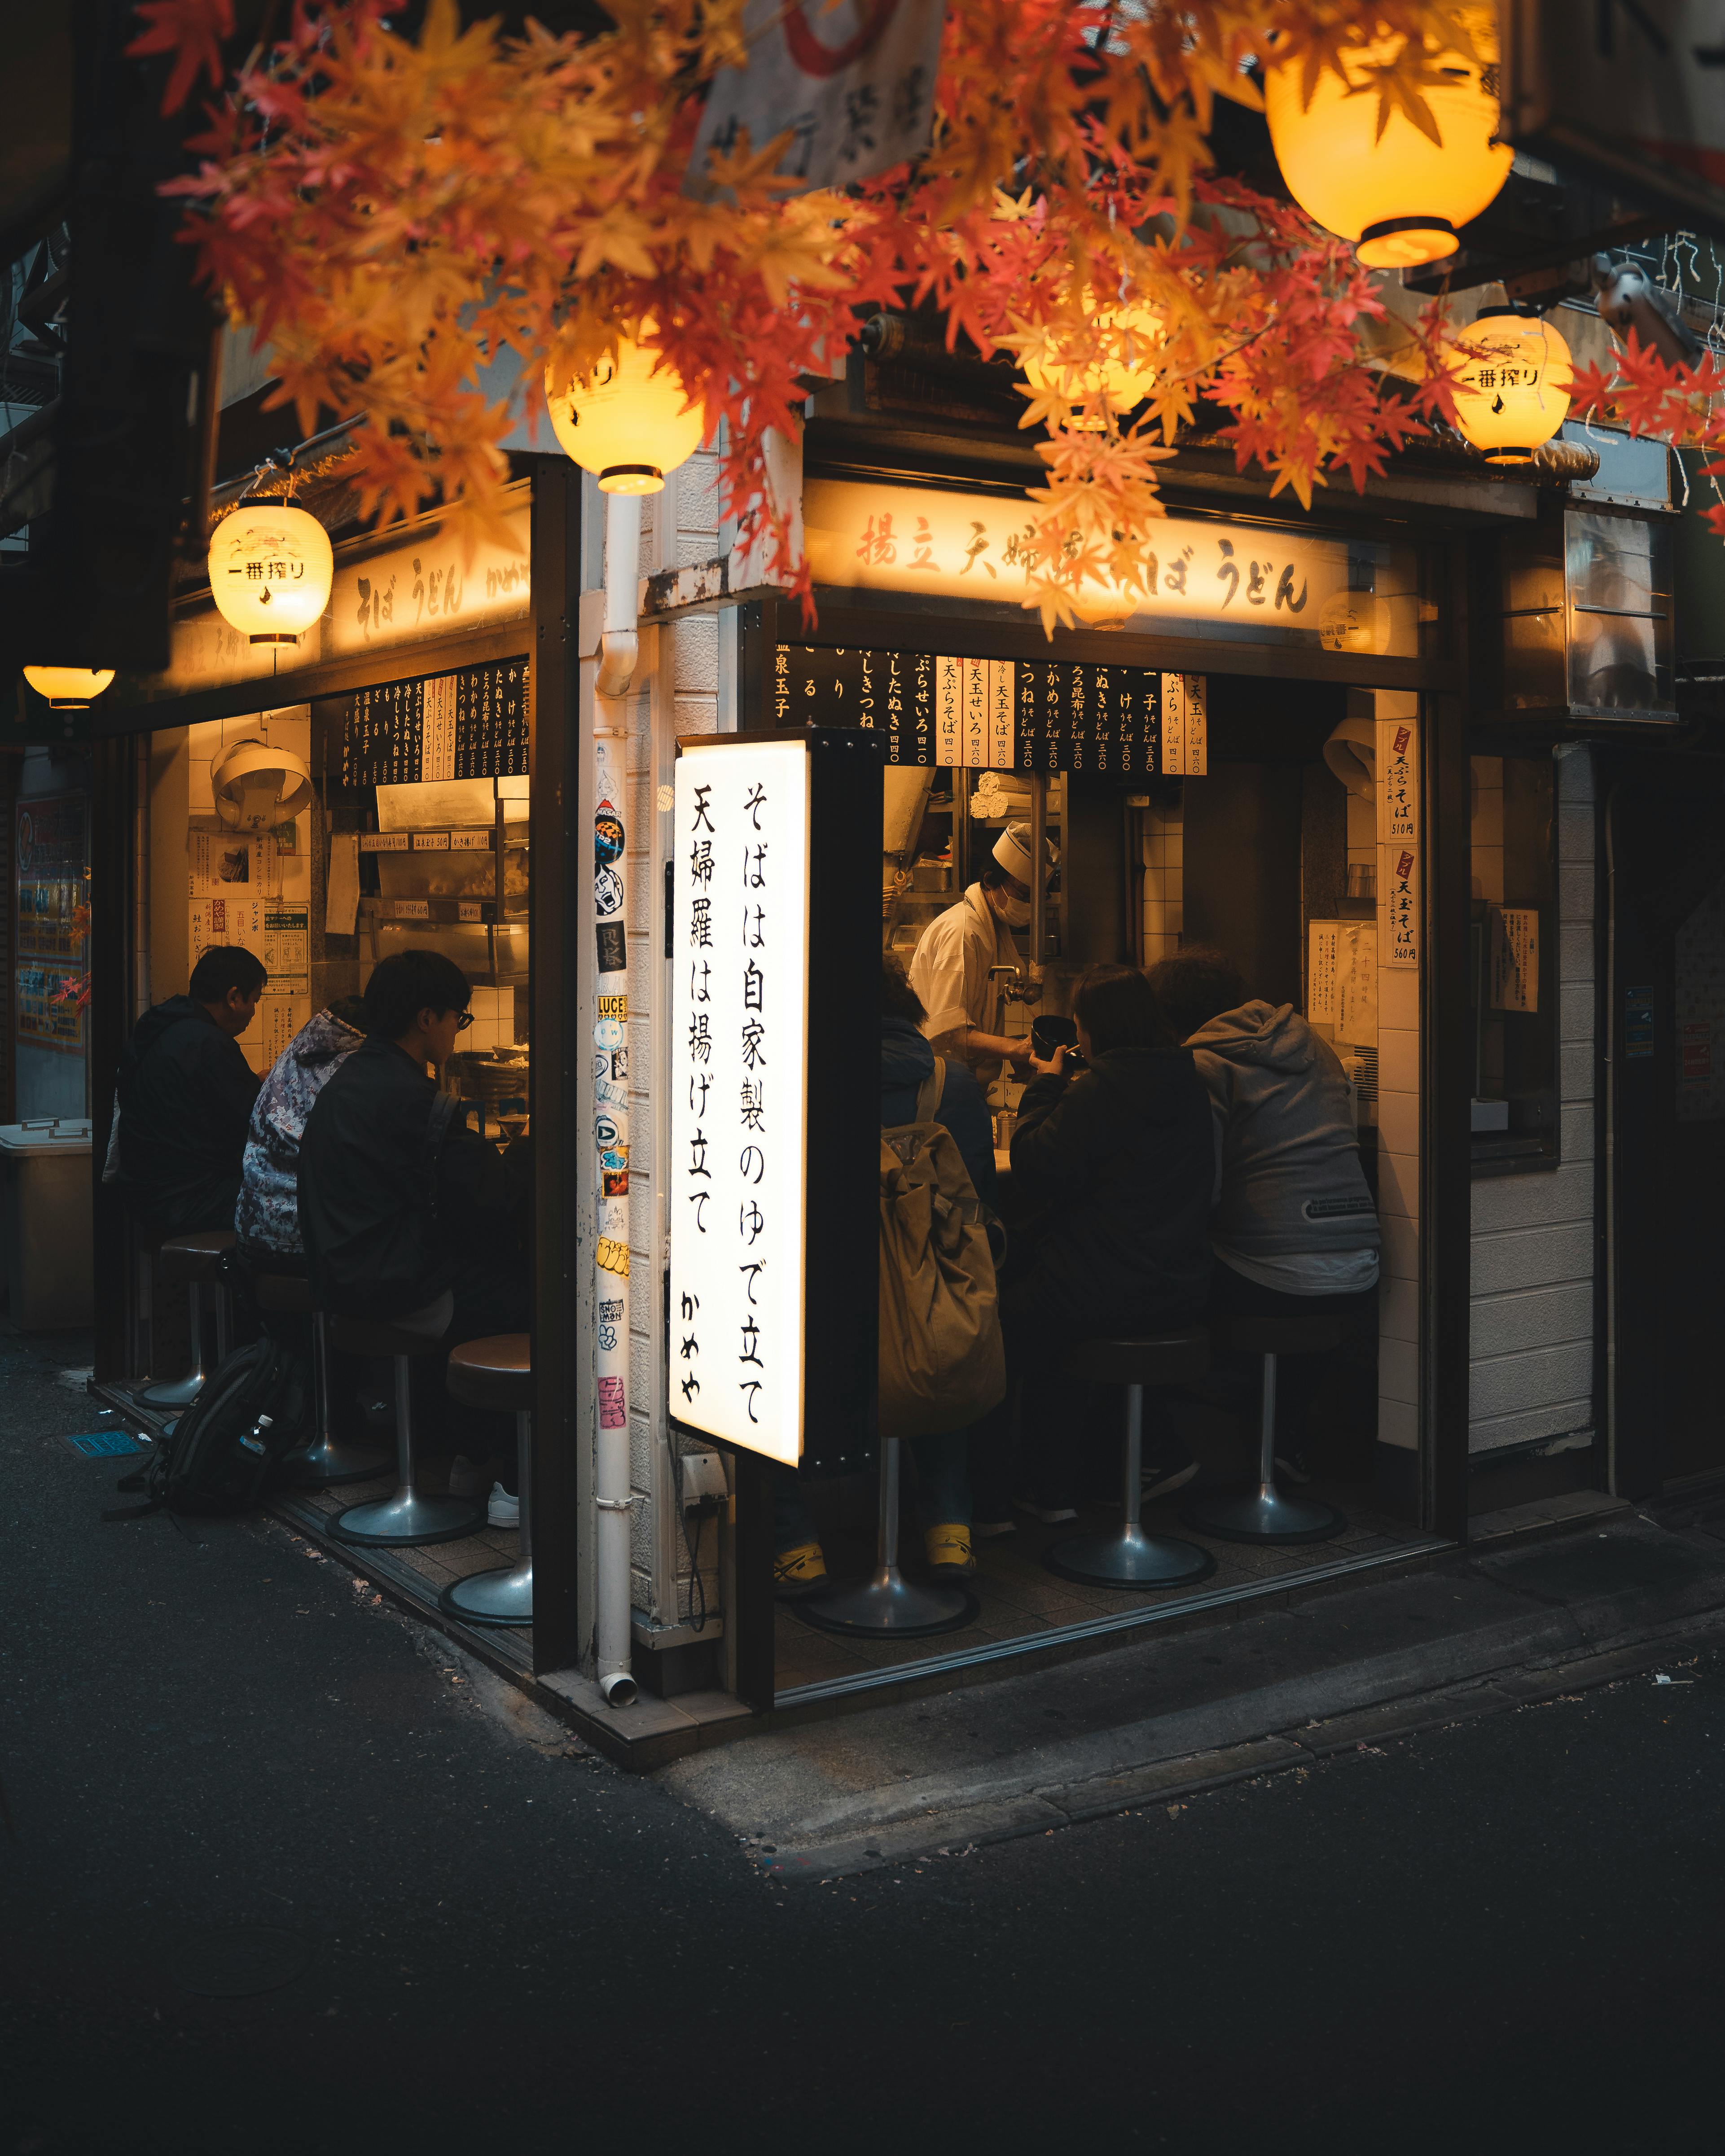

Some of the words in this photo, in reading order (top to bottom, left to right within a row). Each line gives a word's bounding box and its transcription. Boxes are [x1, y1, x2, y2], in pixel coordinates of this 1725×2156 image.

[1462, 369, 1537, 387] 一番搾り
[228, 562, 303, 579] 一番搾り
[1216, 539, 1307, 613] うどん
[495, 669, 503, 718] たぬき
[969, 668, 984, 735] 天玉せいろ
[1047, 664, 1060, 704] かめ
[1143, 671, 1157, 711] 子
[1393, 756, 1410, 819] 天ぷらそば
[436, 837, 448, 847] 50円
[477, 835, 488, 846] 110円
[1391, 822, 1413, 835] 510円
[1396, 881, 1414, 944] 天玉そば
[1394, 947, 1416, 960] 560円
[599, 997, 623, 1013] LUCE
[688, 785, 715, 1233] 天婦羅は揚げ立て
[738, 783, 768, 1424] そばは自家製のゆで立て
[680, 1291, 700, 1405] かめや
